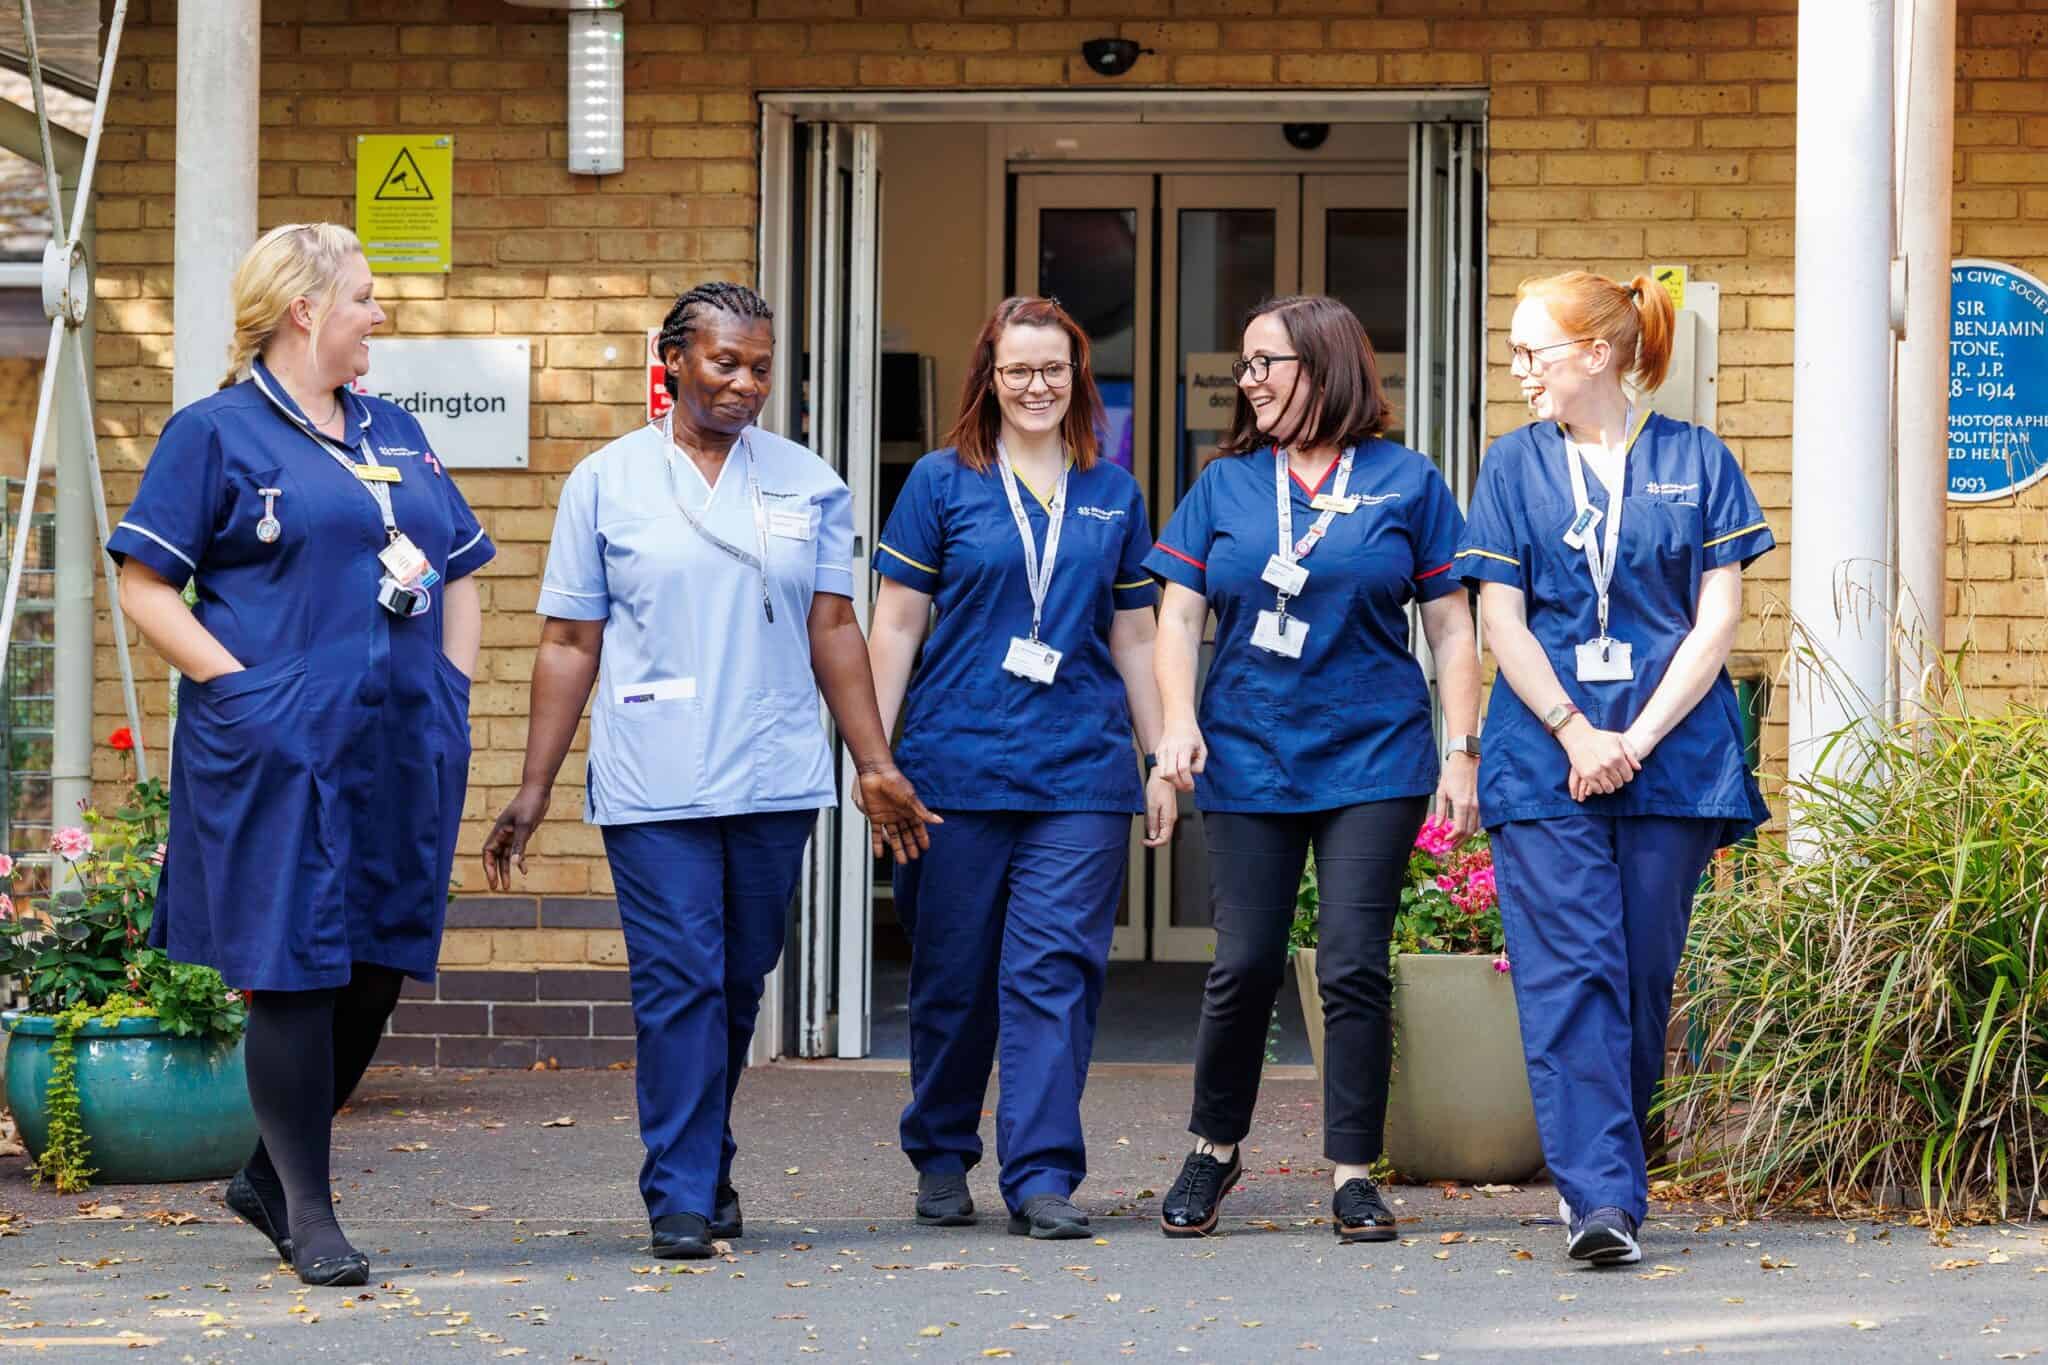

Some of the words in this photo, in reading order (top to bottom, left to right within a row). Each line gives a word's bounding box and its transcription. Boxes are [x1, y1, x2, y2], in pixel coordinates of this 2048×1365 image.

[1967, 271, 2007, 286] CIVIC
[1956, 300, 1986, 316] SIR
[1954, 321, 2044, 337] BENJAMIN
[1949, 341, 2005, 358] TONE,
[1951, 361, 1971, 378] .P.,
[1976, 361, 2005, 377] J.P.
[1951, 476, 1987, 492] 1993
